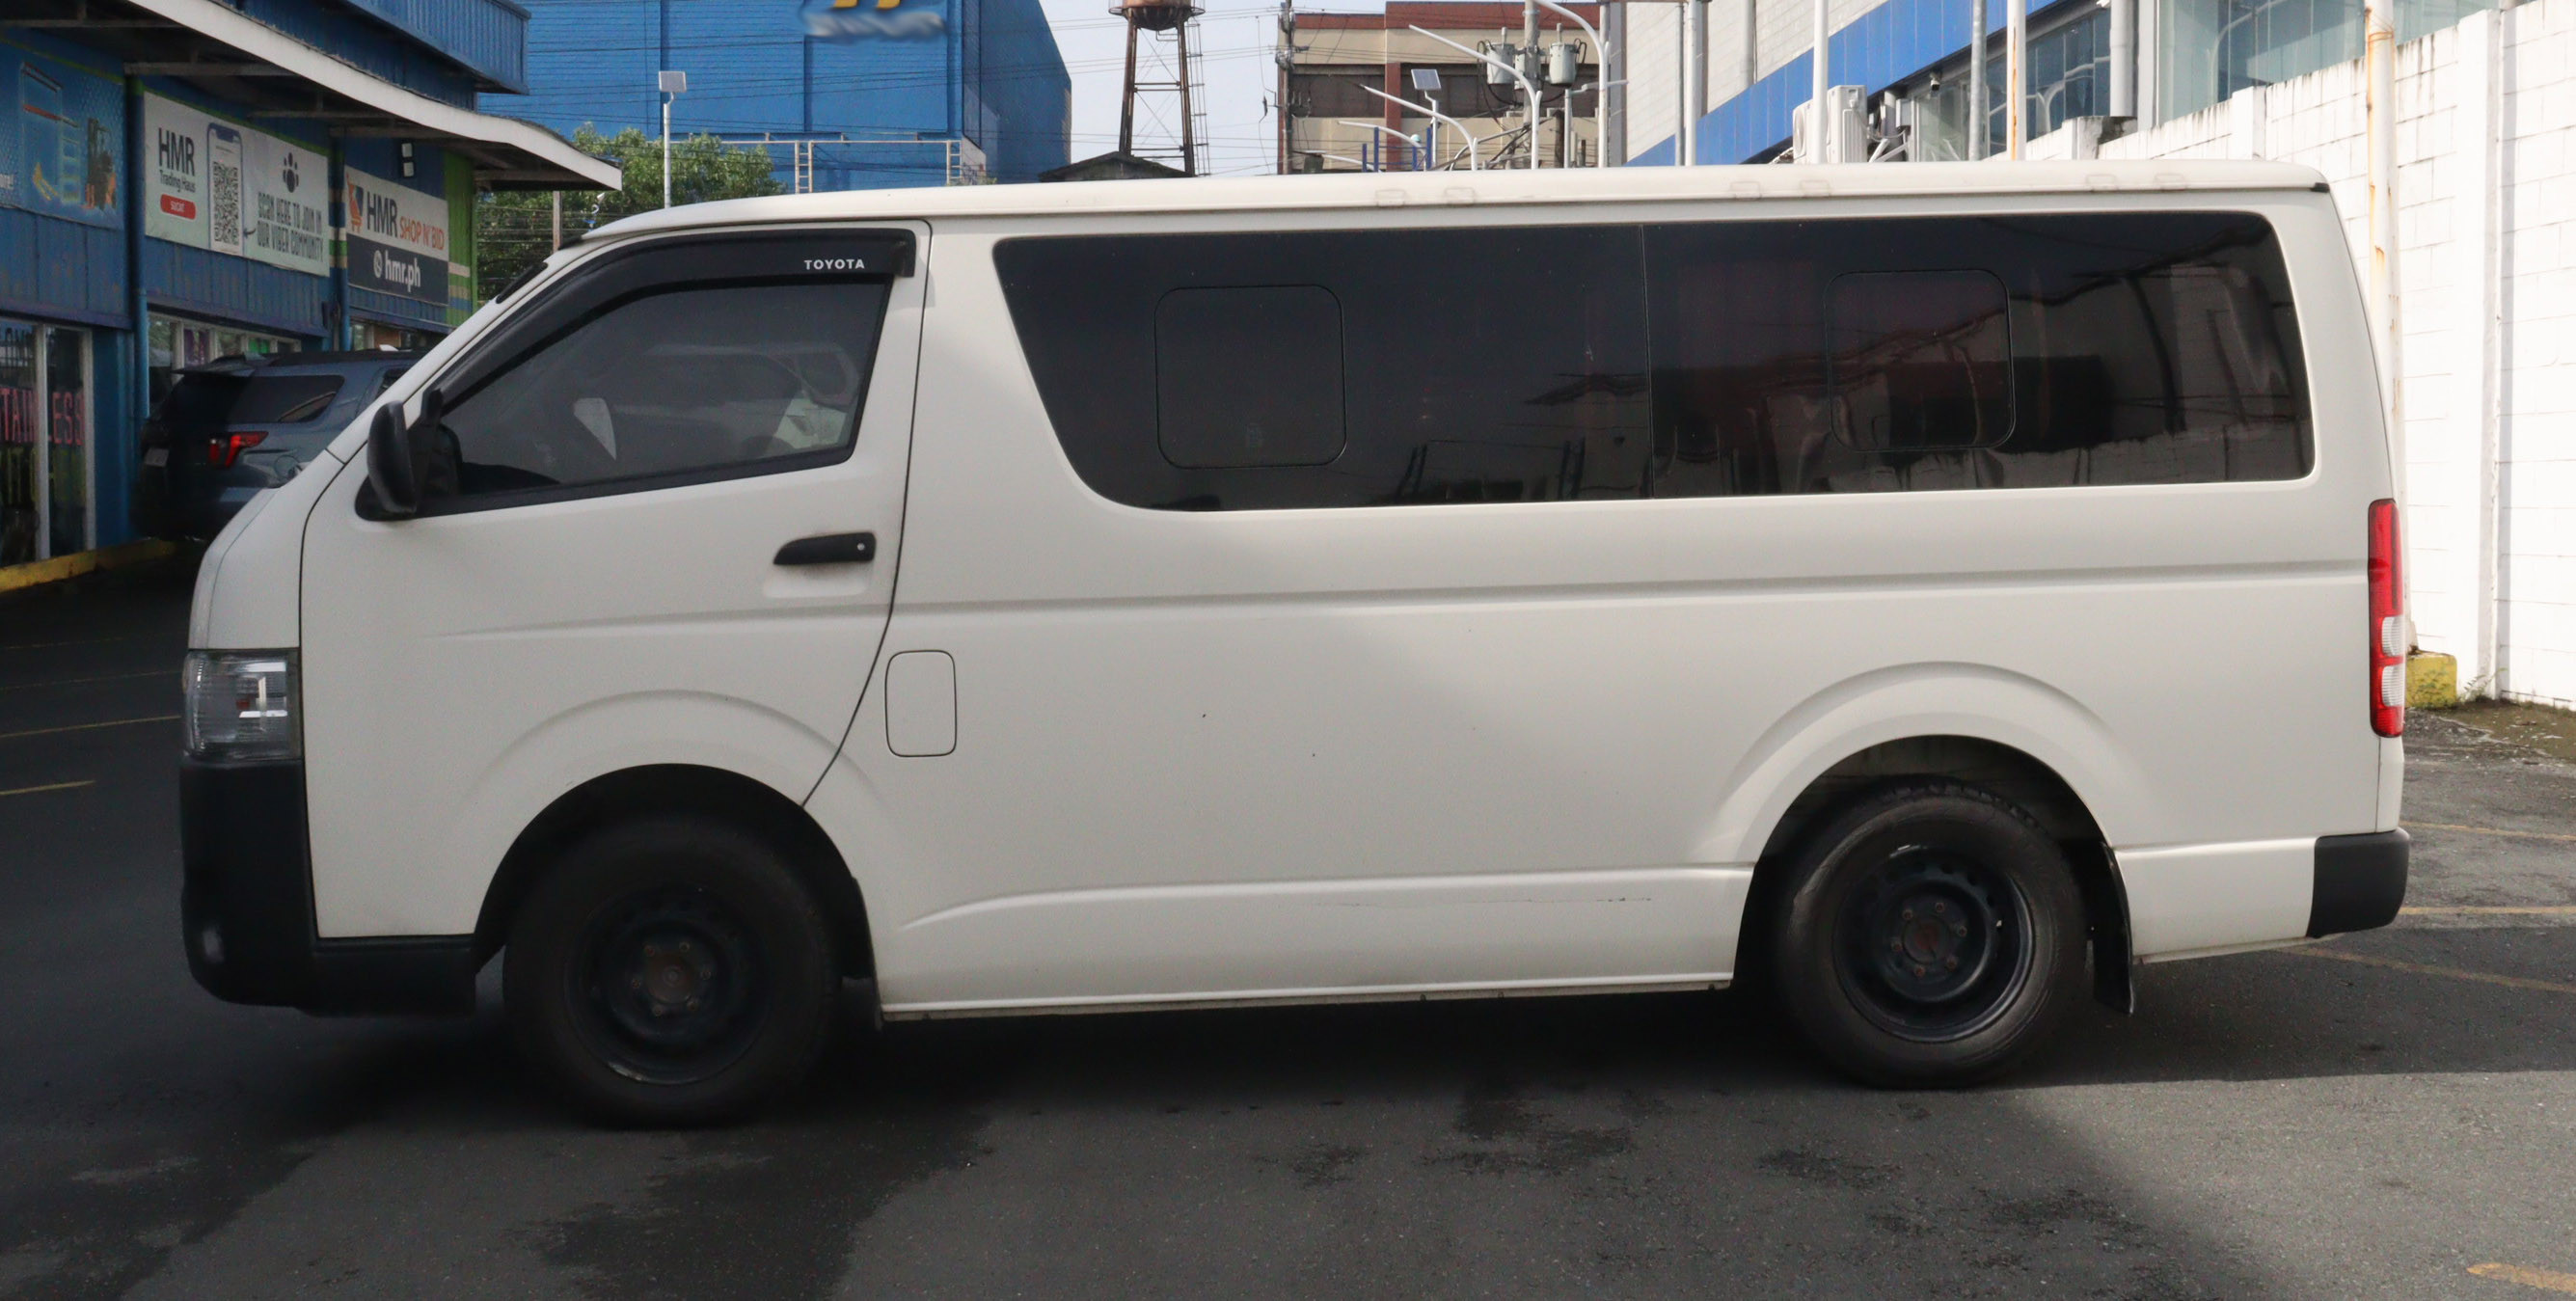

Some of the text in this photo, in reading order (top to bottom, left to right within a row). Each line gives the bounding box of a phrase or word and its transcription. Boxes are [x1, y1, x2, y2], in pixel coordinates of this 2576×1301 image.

[158, 127, 195, 176] HMR
[159, 169, 196, 193] Trading Haus
[258, 192, 322, 235] SCAN HERE TO JOIN IN
[366, 191, 398, 238] HMR
[400, 216, 421, 244] SHOP
[432, 226, 445, 250] BID
[258, 220, 323, 263] OUR VIBER COMMUNITY
[384, 249, 421, 293] hmr.ph
[803, 258, 865, 270] TOYOTA
